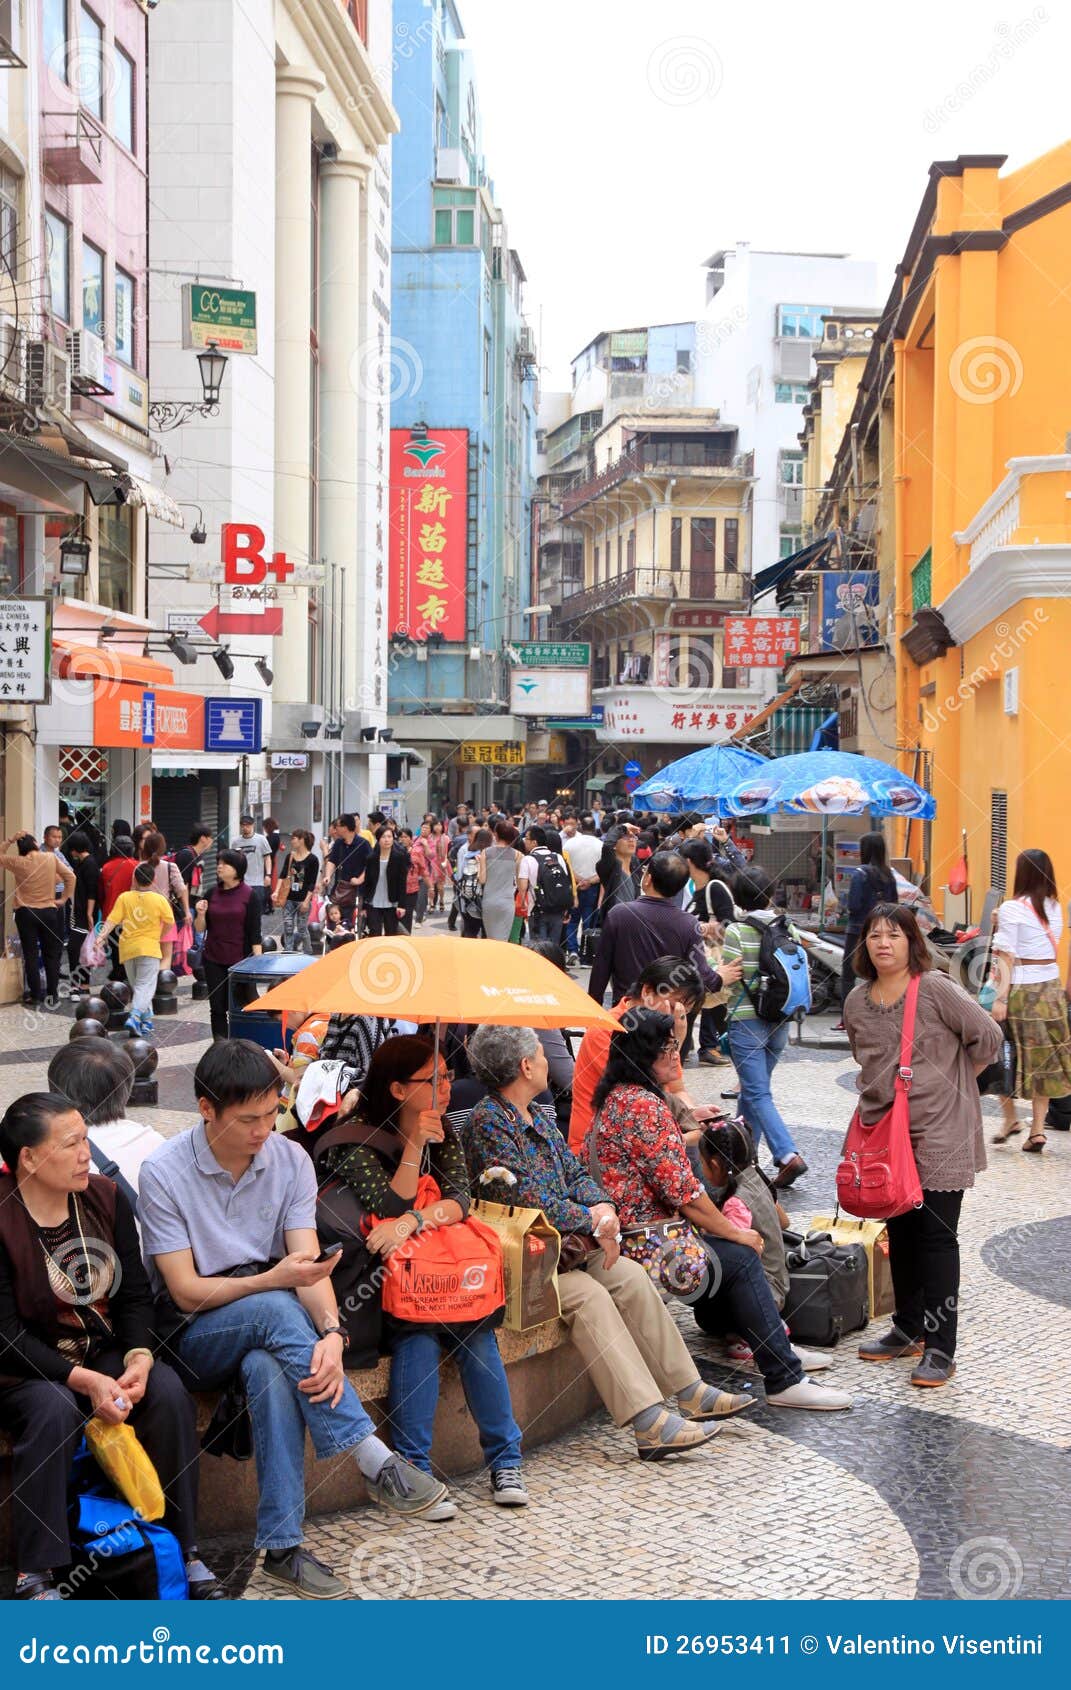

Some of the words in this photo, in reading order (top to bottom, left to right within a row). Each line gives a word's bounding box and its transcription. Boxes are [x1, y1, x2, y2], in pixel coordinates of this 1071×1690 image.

[222, 523, 294, 585] B+
[414, 484, 452, 630] 新苗超市
[6, 612, 30, 620] CHINESA
